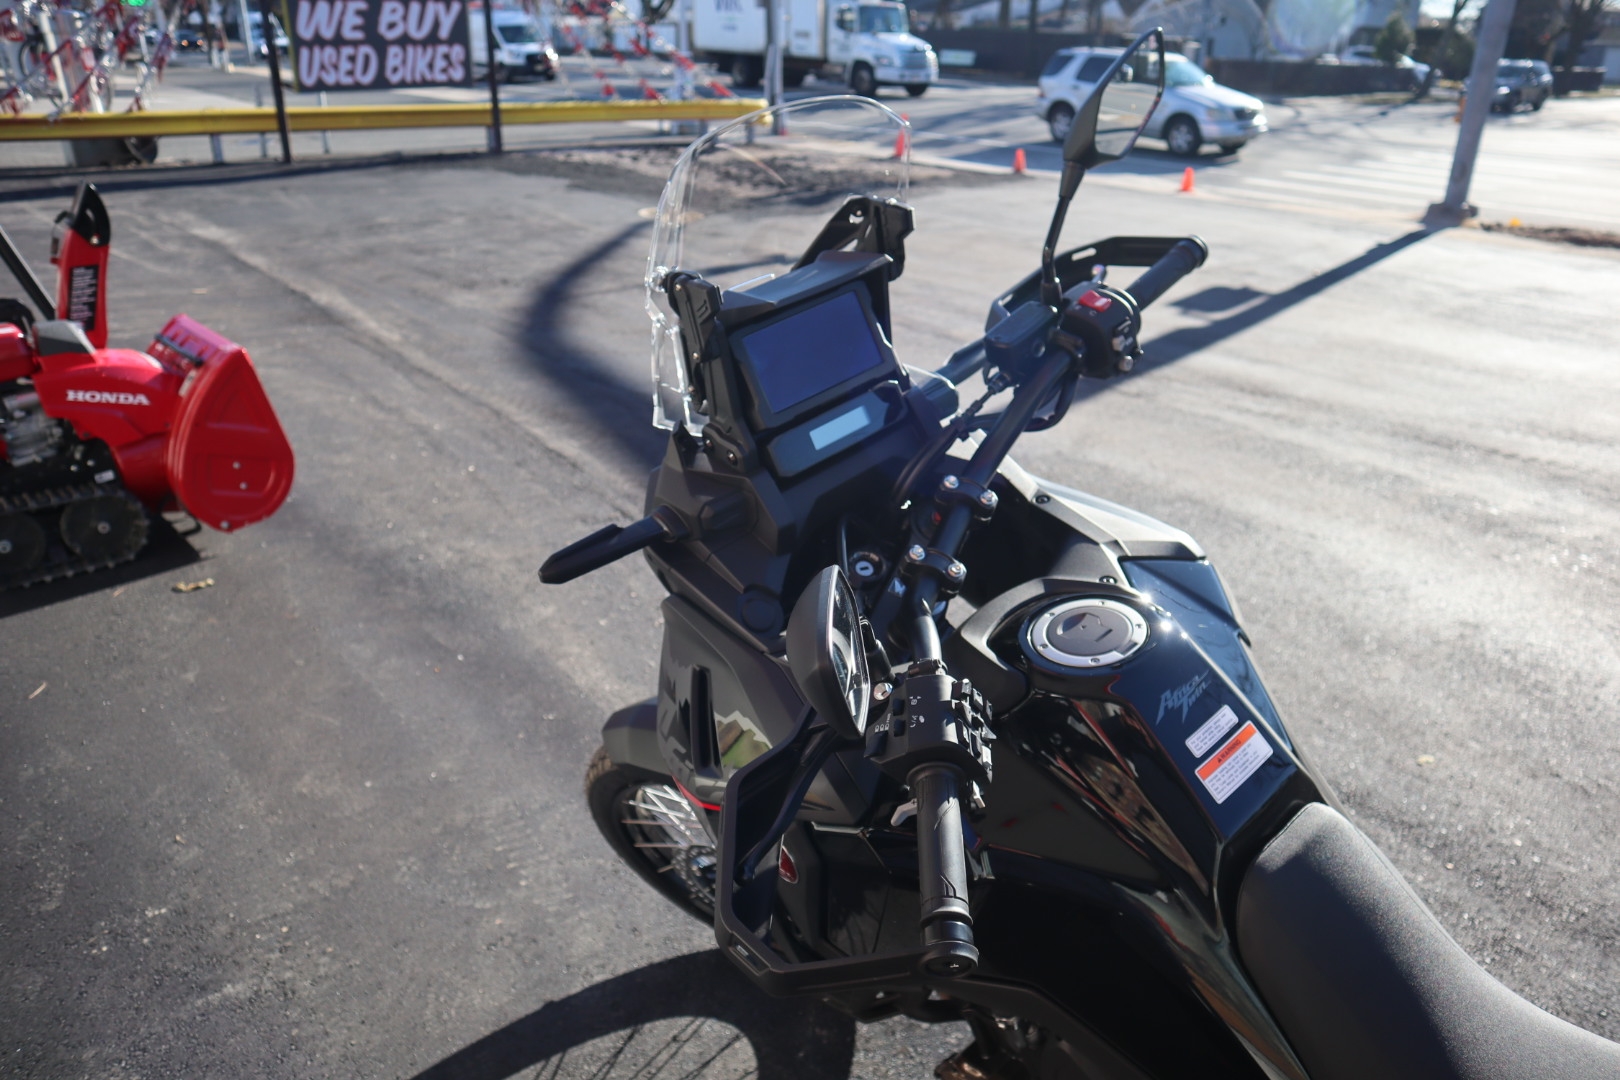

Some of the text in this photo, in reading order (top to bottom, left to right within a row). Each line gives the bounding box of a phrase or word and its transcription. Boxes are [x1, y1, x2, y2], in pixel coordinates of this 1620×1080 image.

[296, 0, 462, 40] WE BUY
[299, 44, 466, 86] USED BIKES
[66, 389, 150, 405] HONDA
[1219, 739, 1241, 759] WARNING
